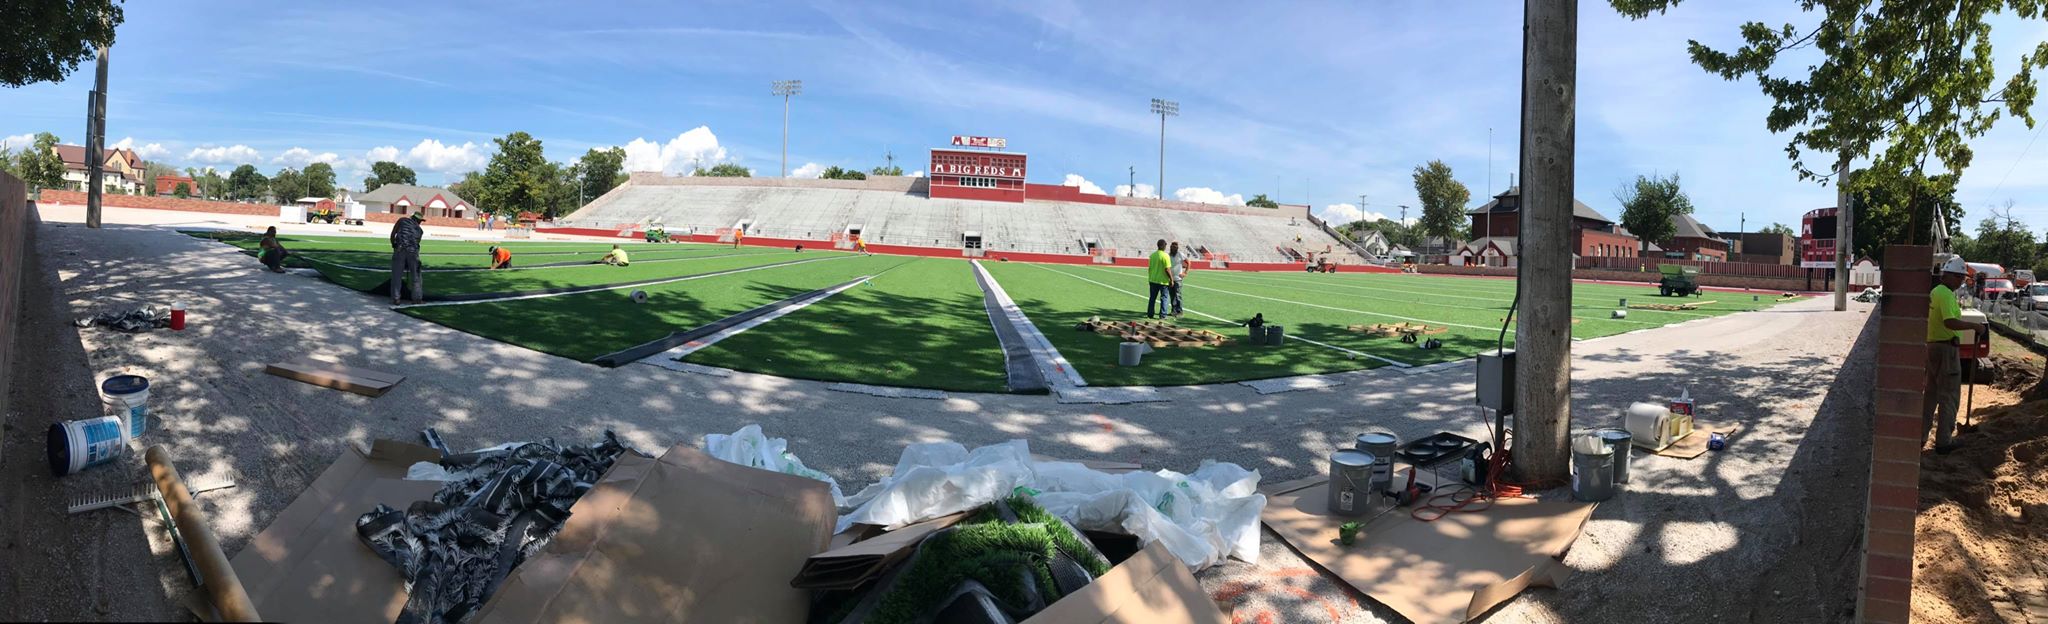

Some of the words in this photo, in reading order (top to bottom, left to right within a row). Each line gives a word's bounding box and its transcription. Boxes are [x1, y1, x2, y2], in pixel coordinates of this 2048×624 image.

[953, 136, 963, 145] M
[935, 164, 944, 173] M
[950, 164, 970, 174] BIG
[974, 166, 1005, 176] REDS
[1012, 168, 1022, 176] M
[1802, 224, 1812, 234] M
